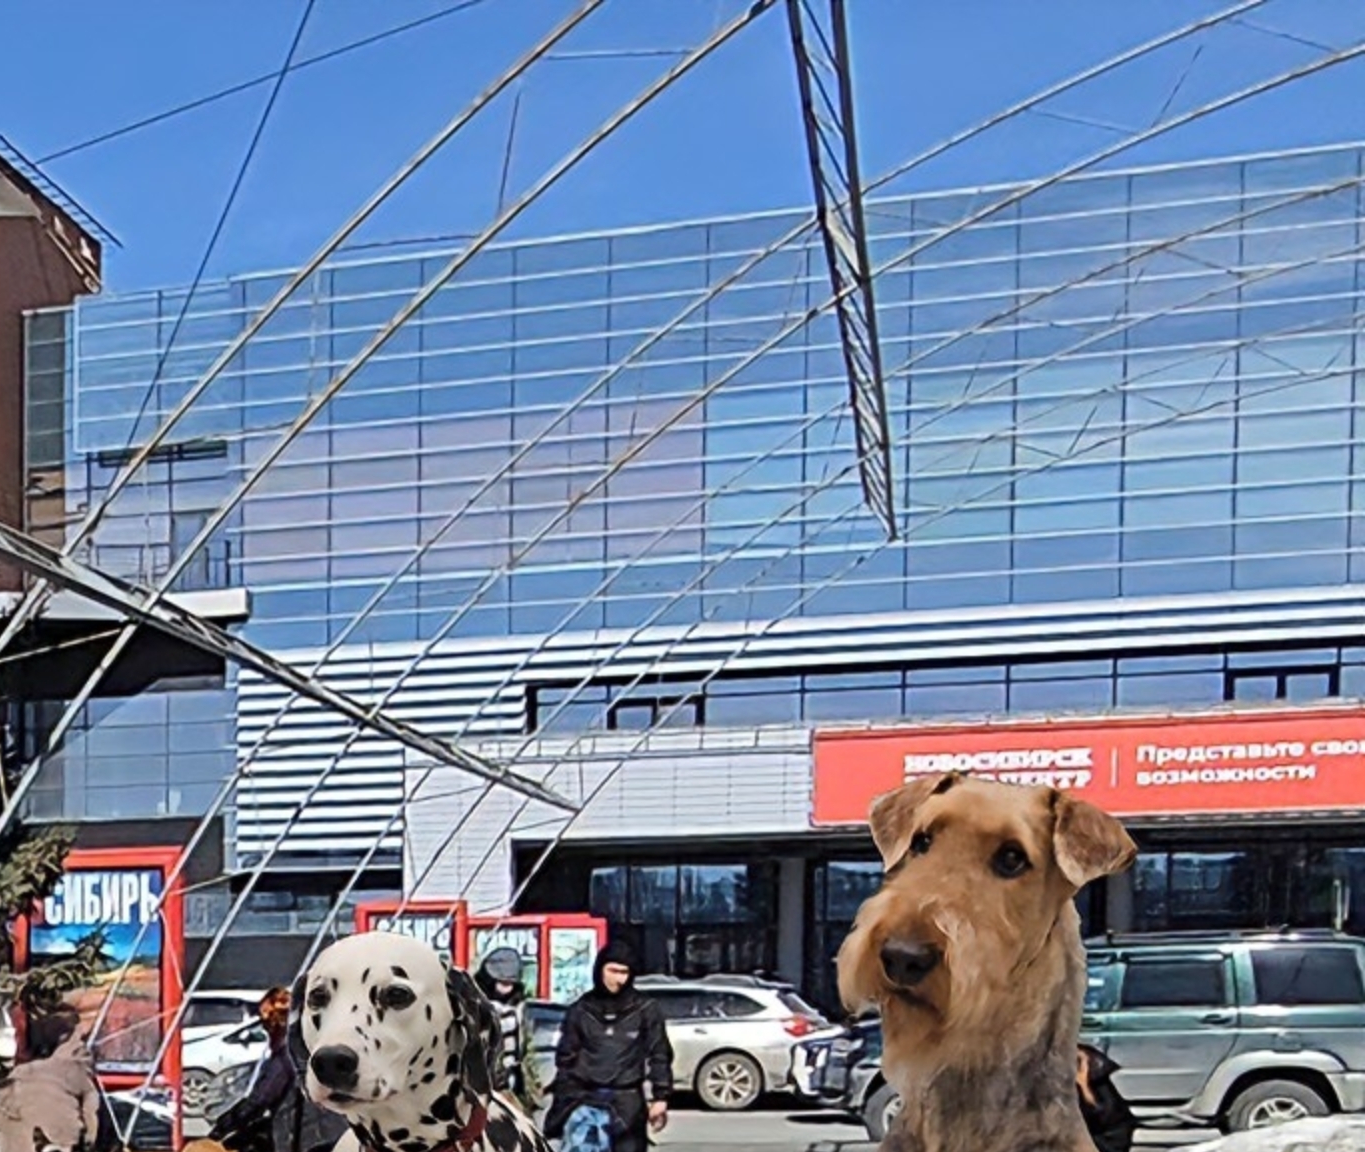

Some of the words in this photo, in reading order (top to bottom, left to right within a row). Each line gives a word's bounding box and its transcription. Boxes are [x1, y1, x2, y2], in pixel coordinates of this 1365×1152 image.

[904, 748, 1093, 774] НОВОСИБИРСК
[1136, 741, 1305, 765] Представьте
[1136, 765, 1316, 786] возможности
[45, 872, 160, 925] СИБИРЬ
